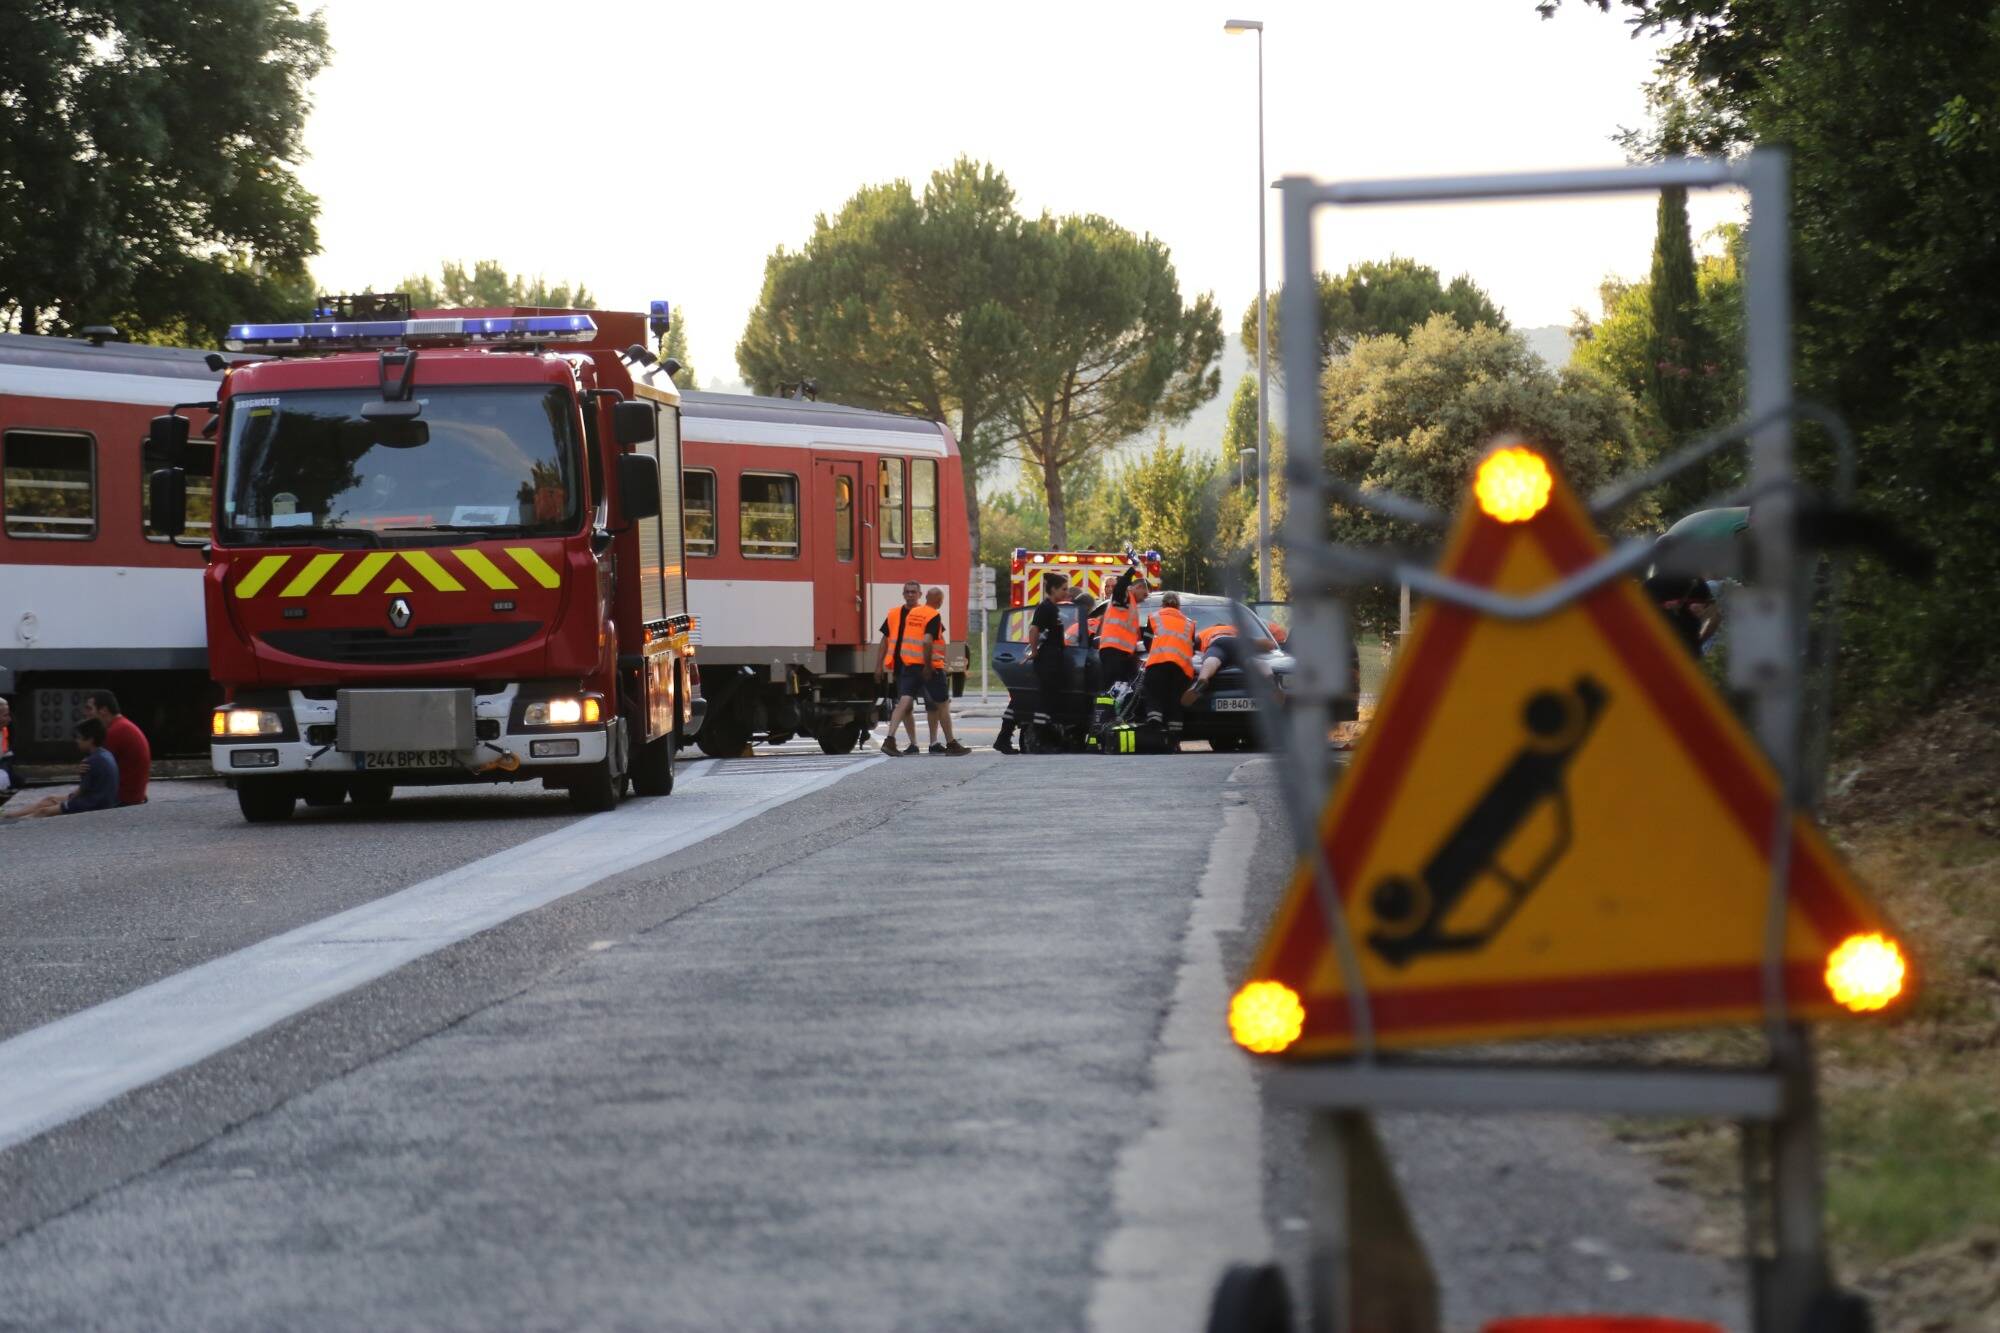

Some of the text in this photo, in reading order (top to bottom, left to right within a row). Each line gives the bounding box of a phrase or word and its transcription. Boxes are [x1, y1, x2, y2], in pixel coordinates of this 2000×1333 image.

[367, 750, 448, 768] 244 BPK 83
